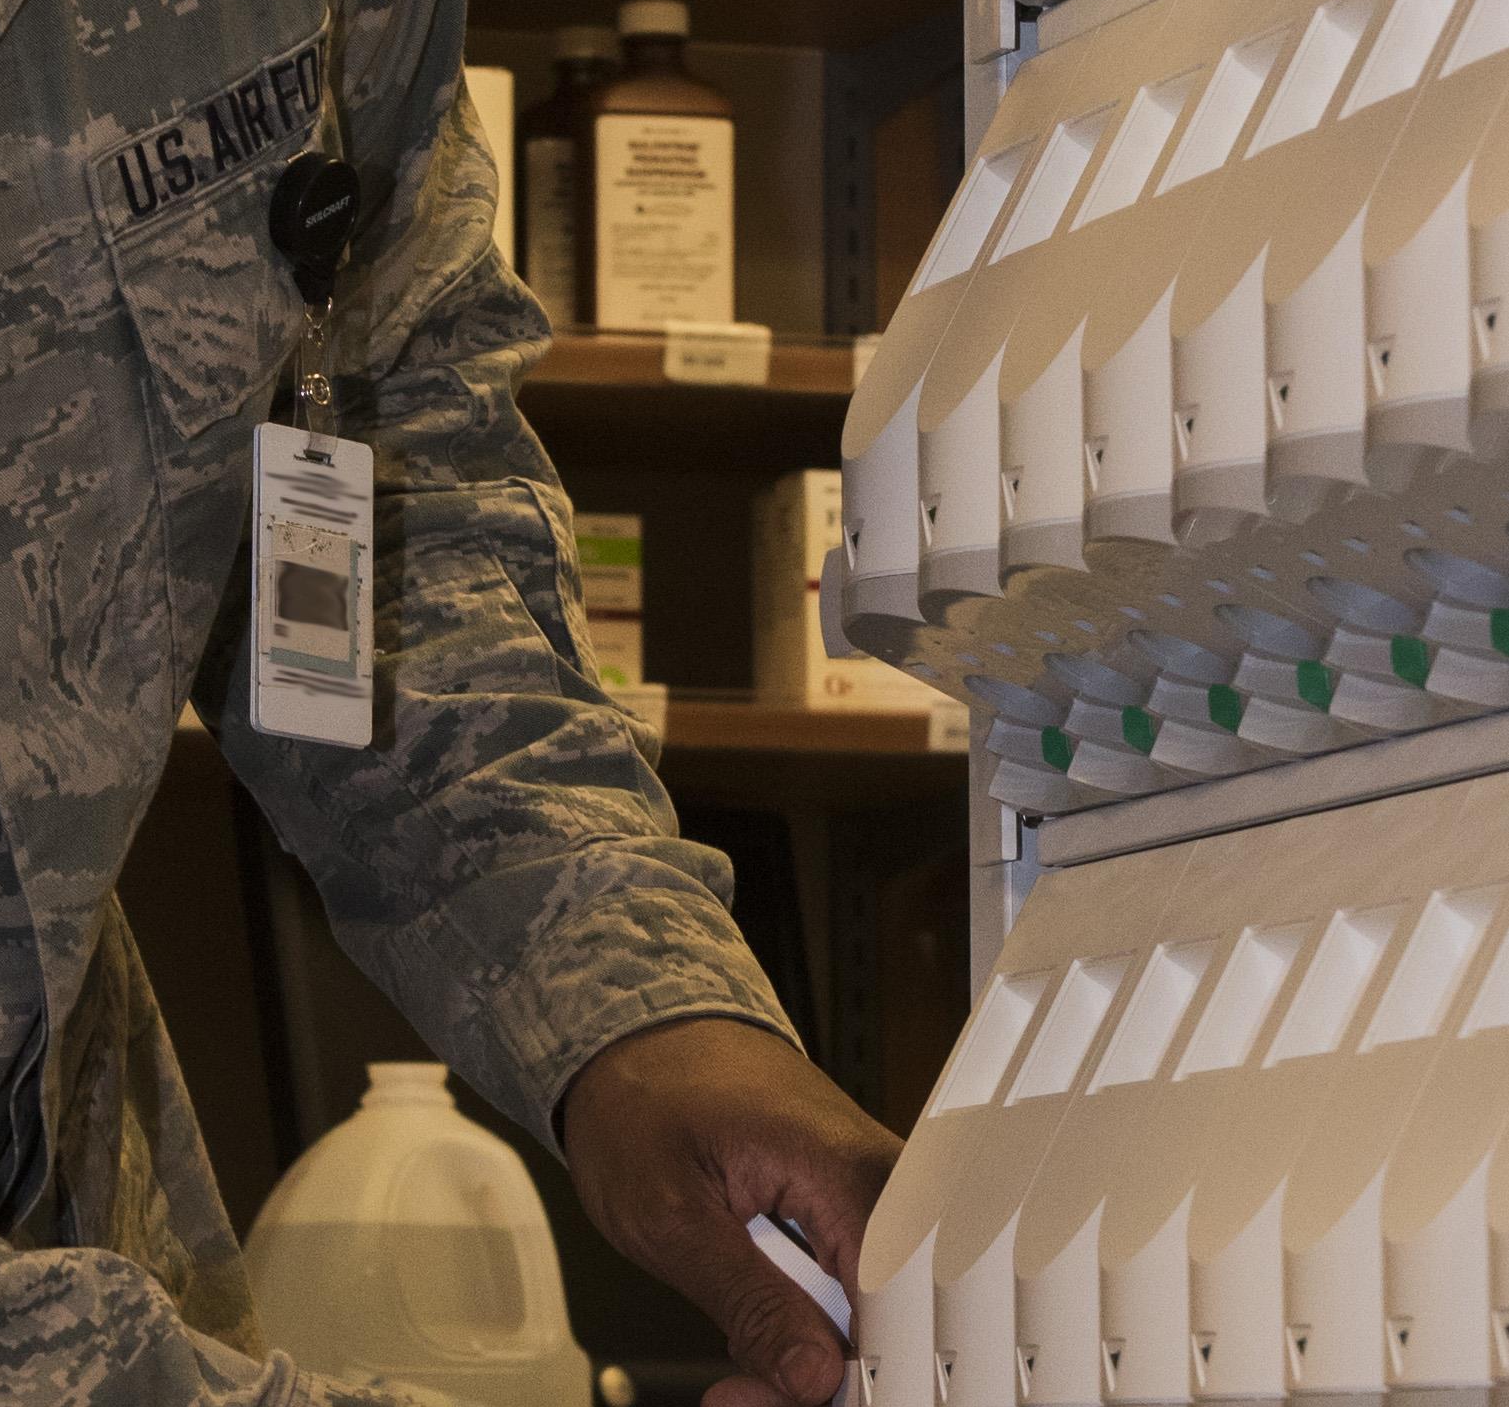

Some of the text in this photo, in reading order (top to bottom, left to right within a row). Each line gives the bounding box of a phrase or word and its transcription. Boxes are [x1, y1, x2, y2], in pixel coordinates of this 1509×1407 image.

[116, 48, 324, 219] U.S. AIR FO
